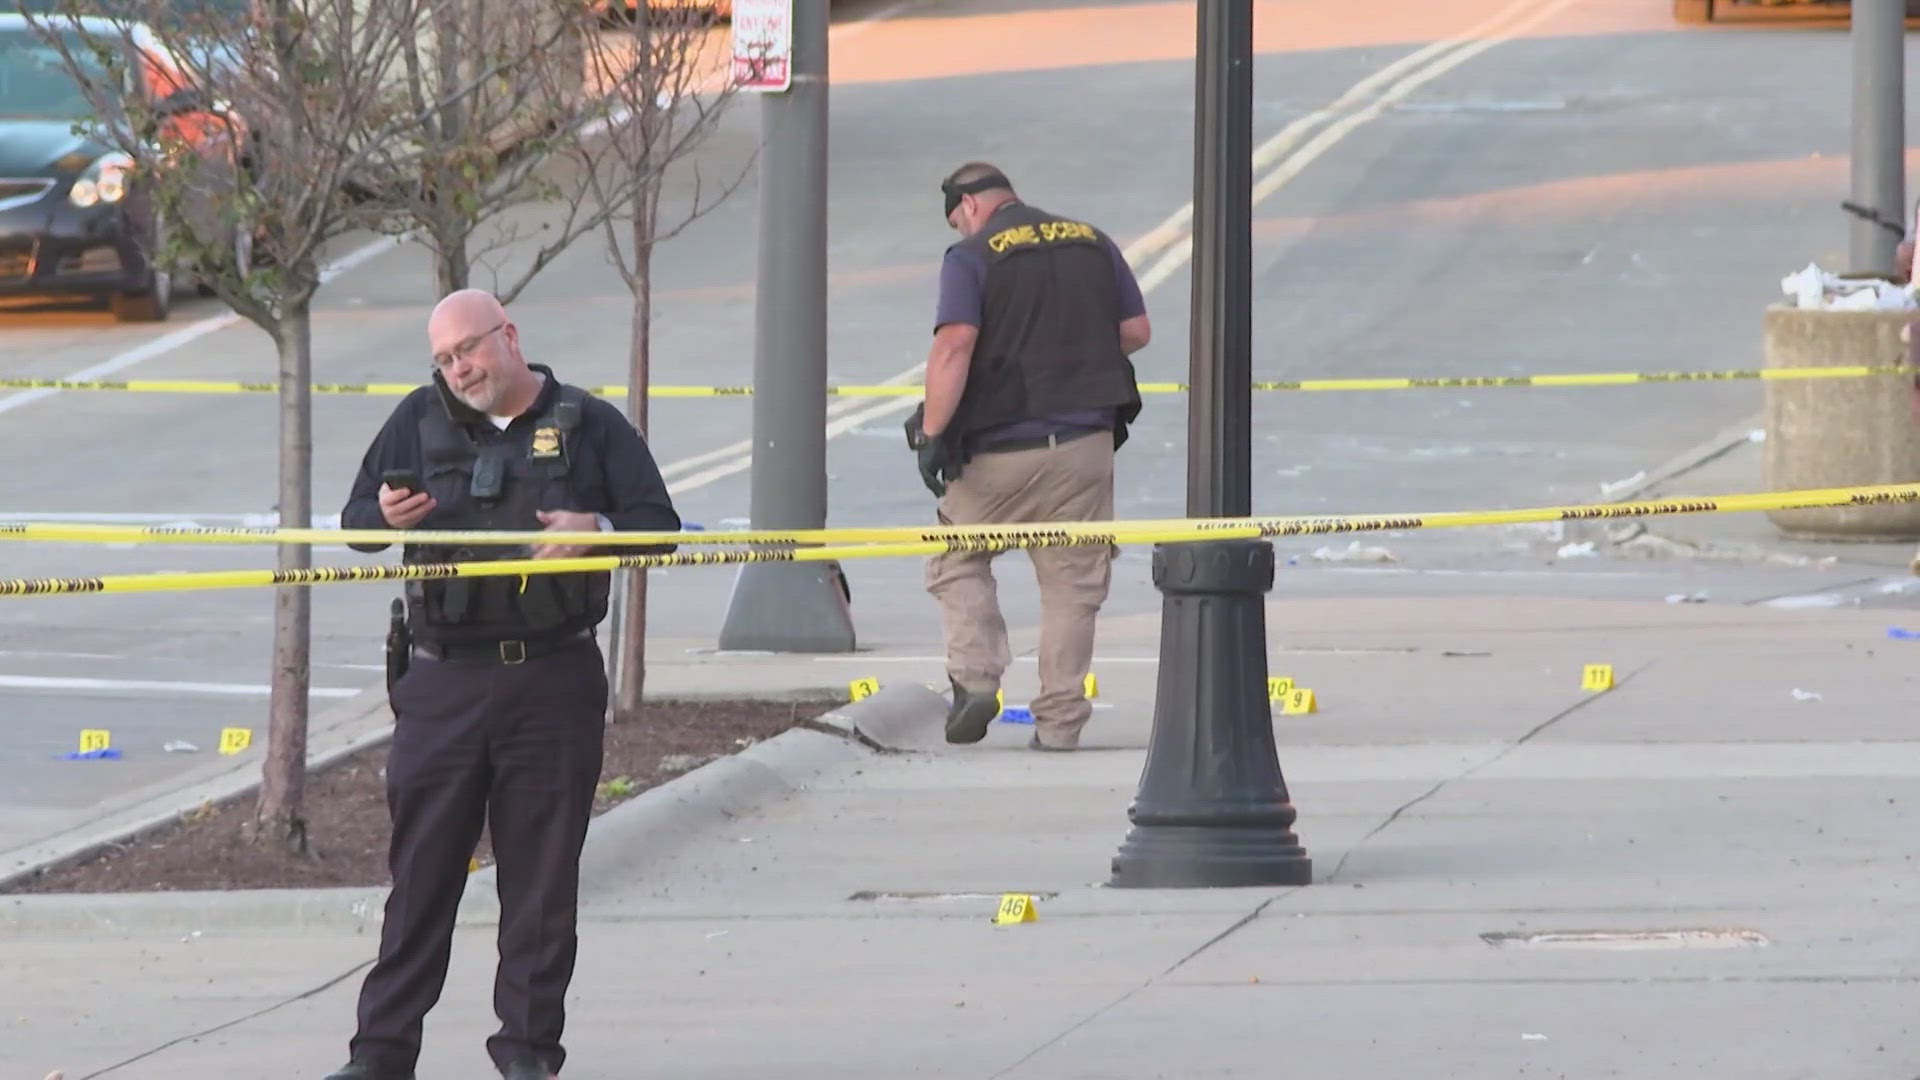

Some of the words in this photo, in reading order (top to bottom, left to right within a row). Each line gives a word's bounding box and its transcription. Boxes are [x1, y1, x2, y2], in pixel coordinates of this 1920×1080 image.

[988, 225, 1040, 252] CRIME
[1592, 668, 1606, 683] 11
[858, 681, 872, 698] 3
[1269, 681, 1289, 696] 10
[1293, 691, 1303, 708] 9
[86, 734, 105, 749] 13
[226, 733, 244, 747] 12
[1002, 898, 1025, 916] 46
